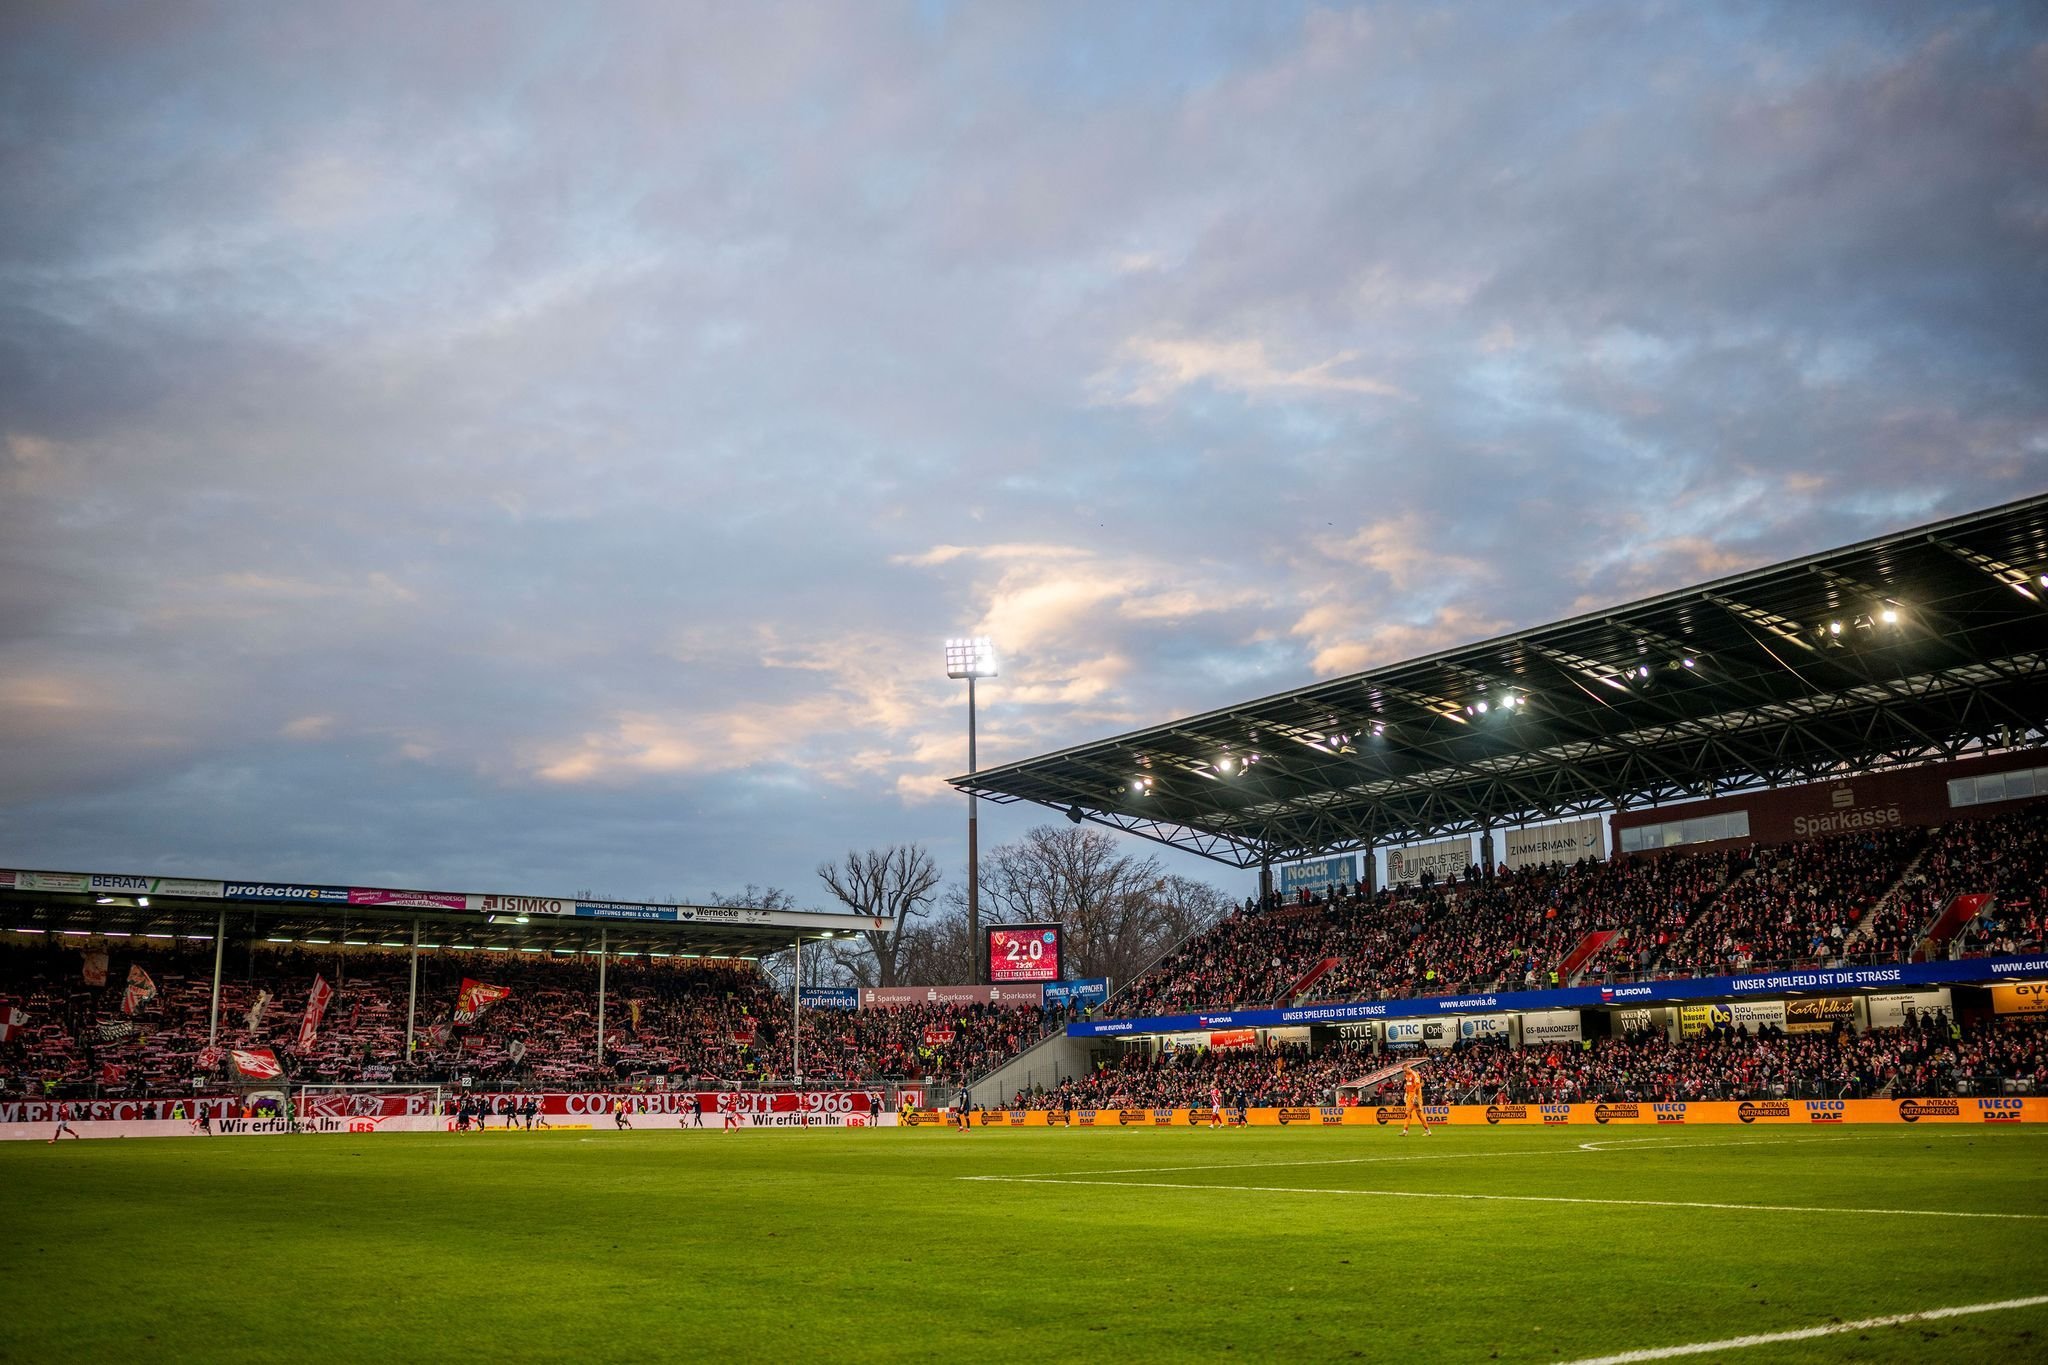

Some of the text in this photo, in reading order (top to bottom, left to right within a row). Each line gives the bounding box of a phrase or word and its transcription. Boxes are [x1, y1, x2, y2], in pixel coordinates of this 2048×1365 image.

[1794, 808, 1900, 837] Sparkasse
[1511, 838, 1576, 856] ZIMMERMANN
[1420, 852, 1464, 866] INDUSTRIE
[1288, 863, 1328, 880] Noack
[1420, 862, 1464, 874] MONTAGE
[92, 875, 148, 889] BERATA
[225, 885, 319, 898] protectors
[501, 897, 562, 913] ISIMKO
[696, 907, 738, 917] Wernecke
[1006, 940, 1042, 961] 2:0
[1733, 970, 1900, 990] UNSER SPIELFELD IST DIE STRASSE
[1046, 986, 1070, 996] OPPACHER
[1079, 983, 1104, 993] OPPACHER
[1616, 988, 1652, 996] EUROVIA
[2016, 984, 2048, 995] GV
[1440, 997, 1497, 1009] www.eurovia.de
[1283, 1006, 1386, 1020] UNSER SPIELFELD IST DIE STRASSE
[1735, 1011, 1783, 1021] strohmeier
[1095, 1022, 1132, 1031] www.eurovia.de
[1398, 1025, 1419, 1035] TRC
[1473, 1020, 1496, 1030] TRC
[1526, 1024, 1579, 1034] GS-BAUKONZEPT
[1340, 1026, 1371, 1038] STYLE
[717, 1093, 777, 1113] SEIT
[1653, 1103, 1686, 1112] IVECO
[1806, 1101, 1844, 1110] IVECO
[1978, 1099, 2023, 1109] IVECO
[1540, 1105, 1570, 1113] IVECO
[1900, 1107, 1958, 1115] NUTZFAHRZEUGE
[753, 1115, 774, 1125] Wir
[826, 1114, 840, 1125] Ihr
[847, 1118, 864, 1127] LBS
[219, 1119, 248, 1133] Wir
[320, 1118, 341, 1131] Ihr
[350, 1123, 374, 1132] LBS
